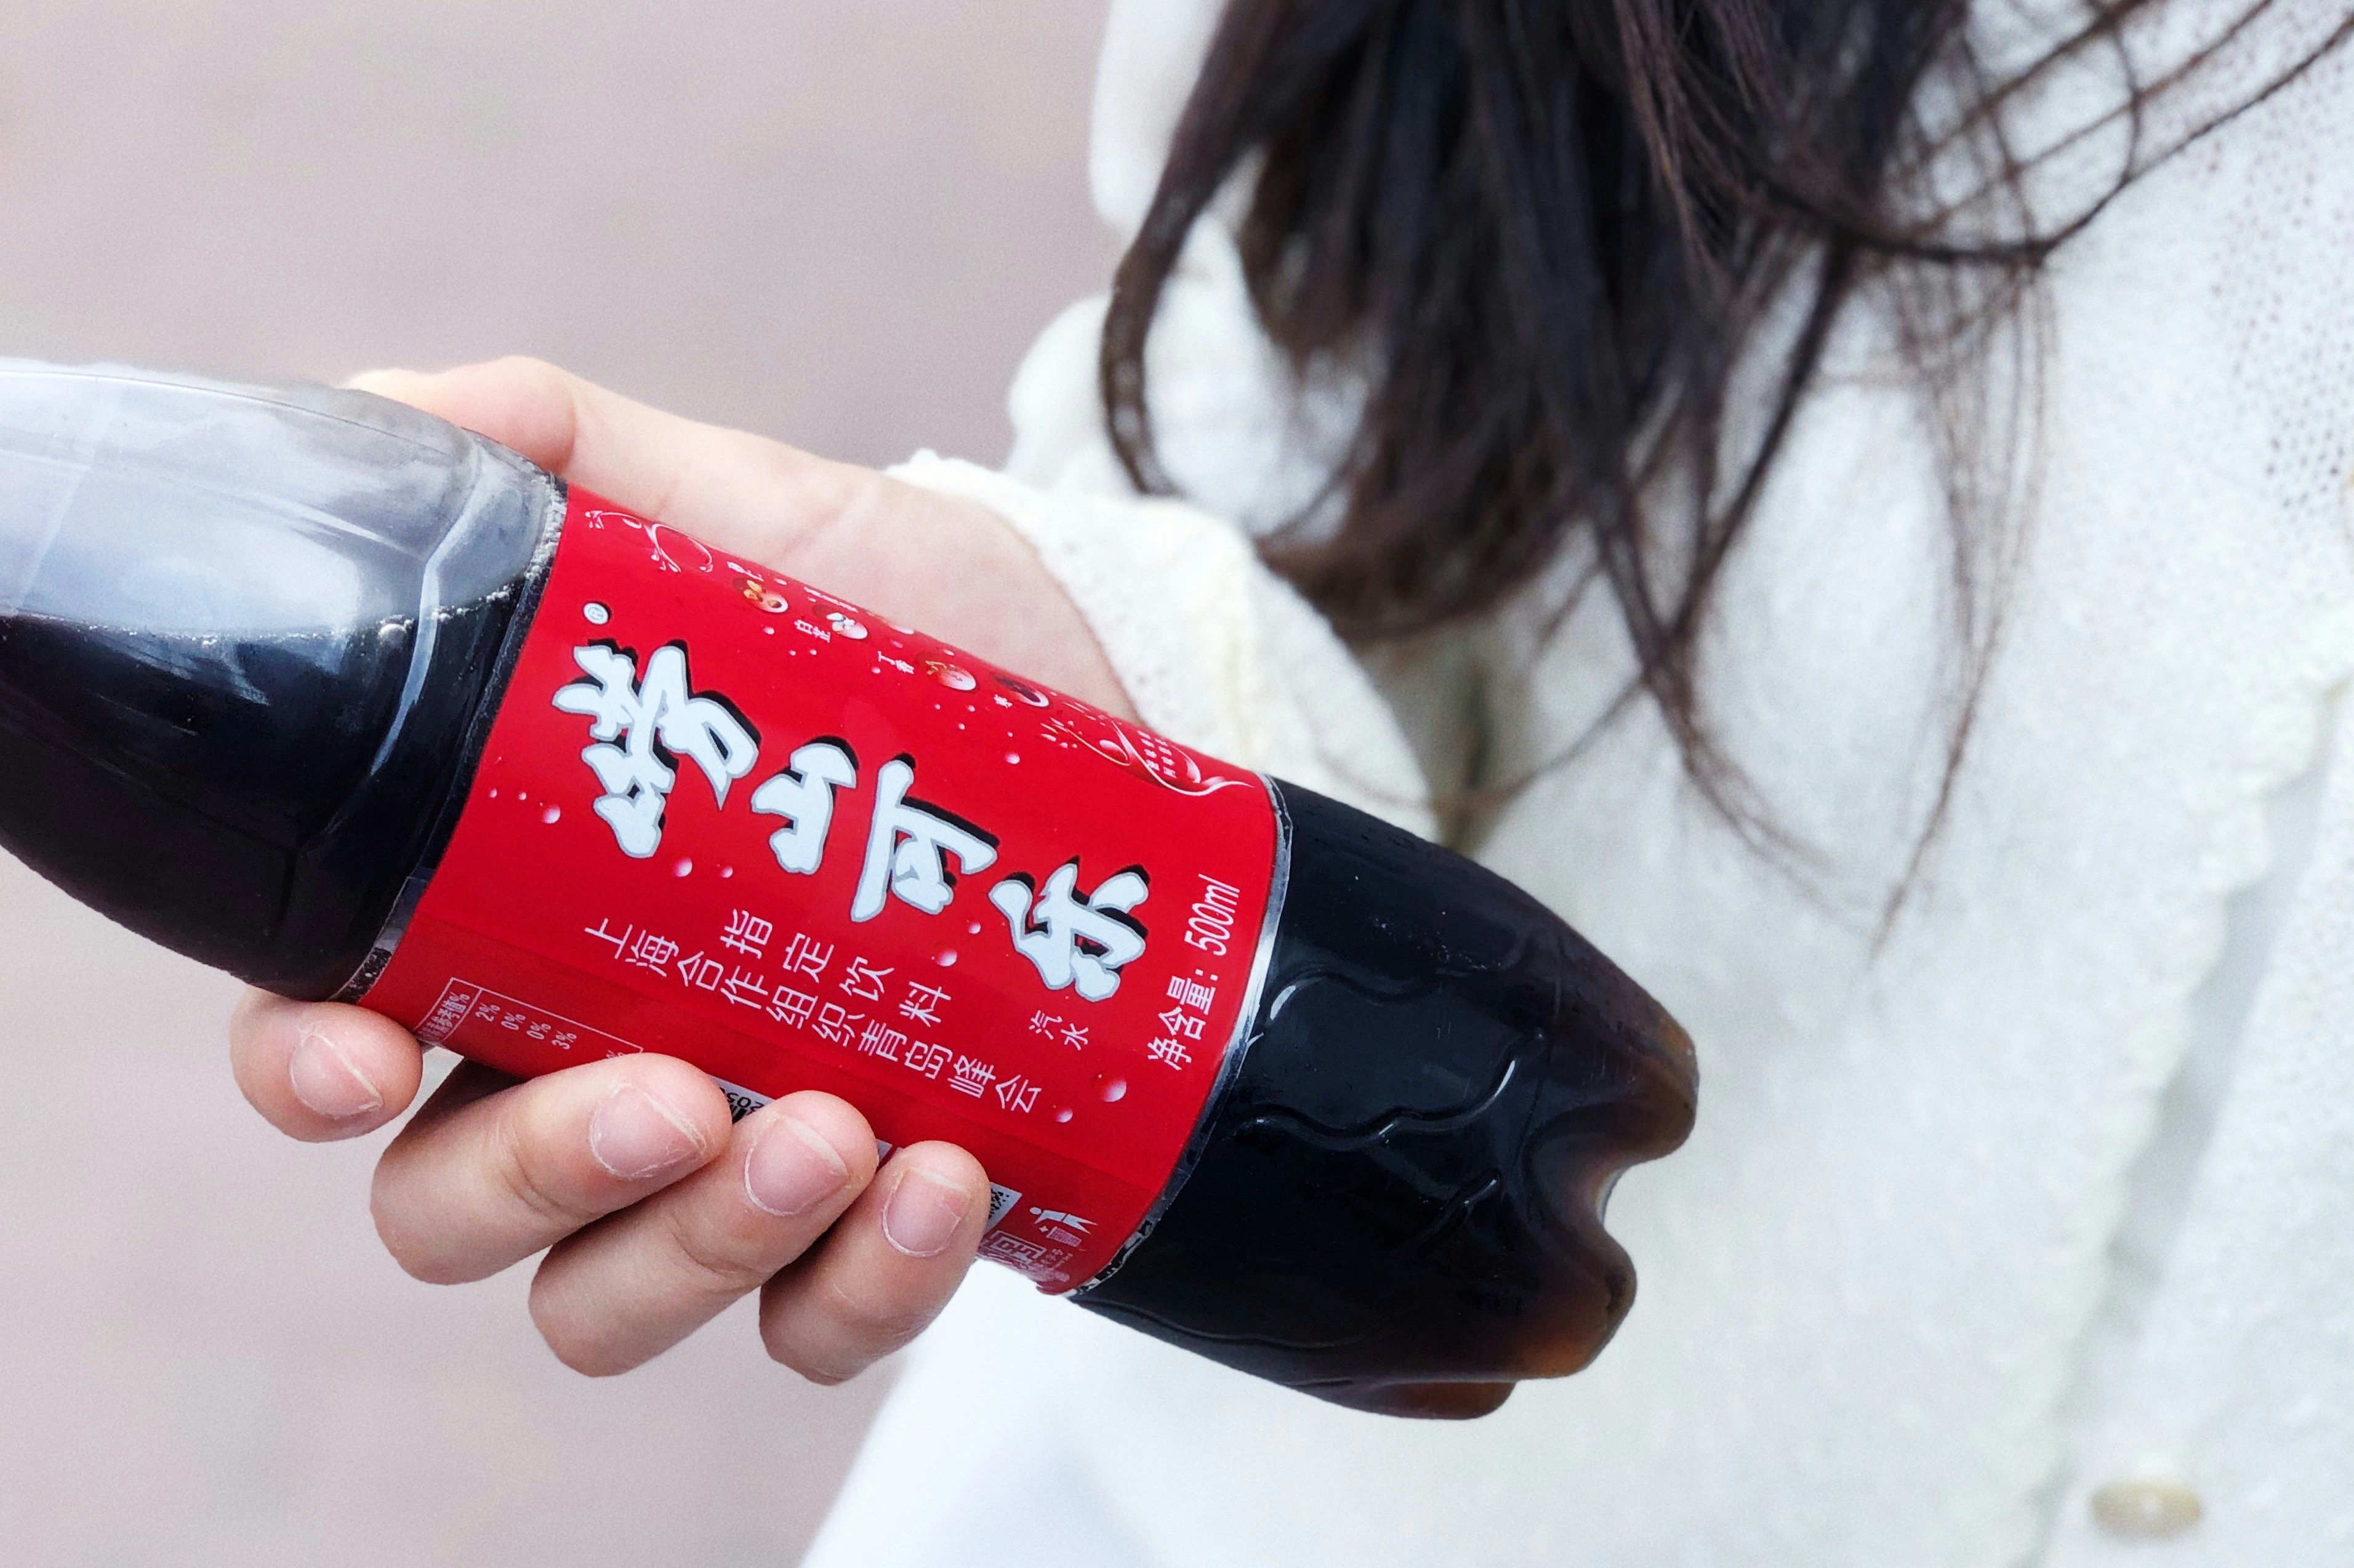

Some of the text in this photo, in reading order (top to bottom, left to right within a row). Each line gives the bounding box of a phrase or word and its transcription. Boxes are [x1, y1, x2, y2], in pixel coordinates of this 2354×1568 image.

[1184, 873, 1240, 956] 500ml
[720, 908, 952, 1027] 指定饮料
[475, 1002, 500, 1022] 2%
[500, 1011, 526, 1031] 0%
[585, 918, 1042, 1113] 上海合作组织青岛峰会
[526, 1021, 552, 1040] 0%
[552, 1031, 577, 1050] 3%
[1029, 1010, 1089, 1051] 汽水
